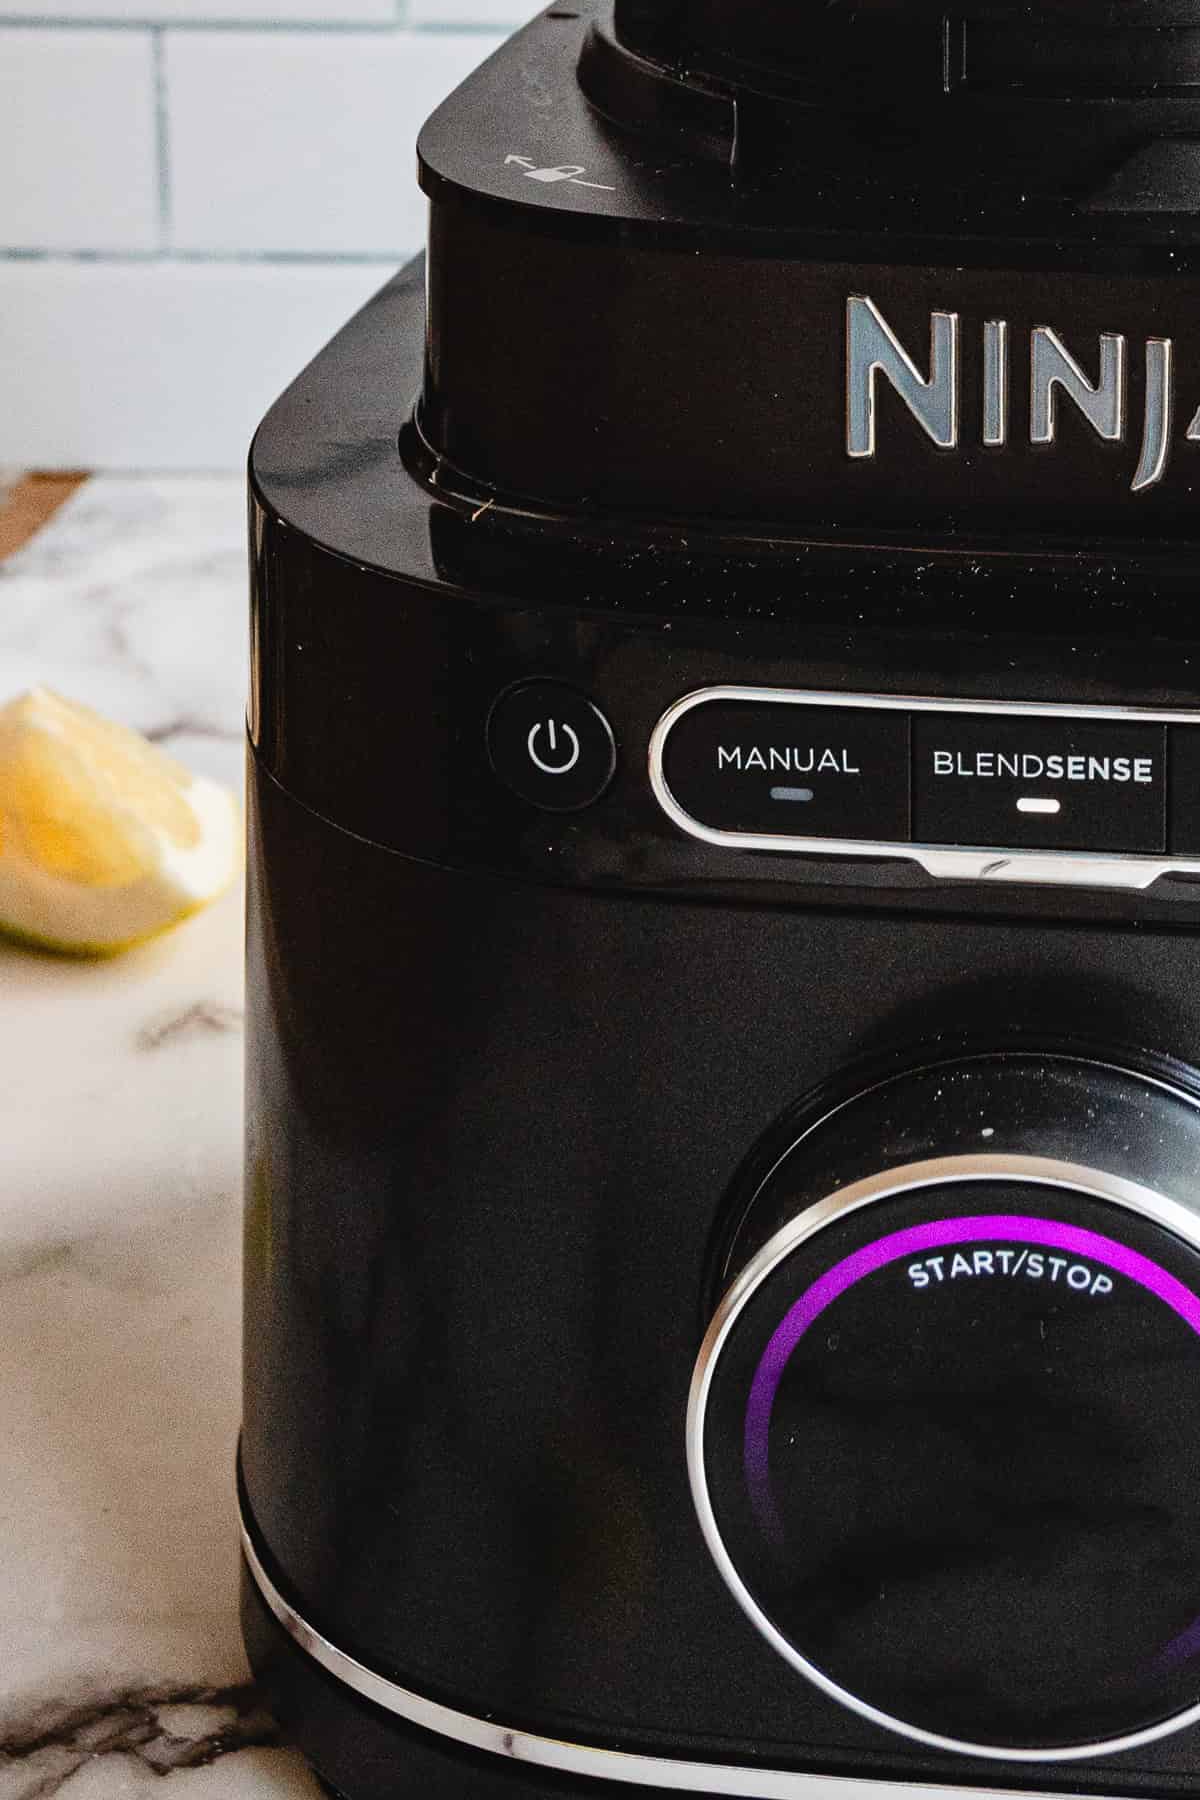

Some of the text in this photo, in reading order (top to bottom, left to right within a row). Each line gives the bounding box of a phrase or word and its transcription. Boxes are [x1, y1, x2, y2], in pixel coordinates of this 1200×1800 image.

[716, 745, 860, 774] MANUAL
[933, 750, 1153, 783] BLENDSENSE
[907, 1249, 1113, 1295] START/STOP
